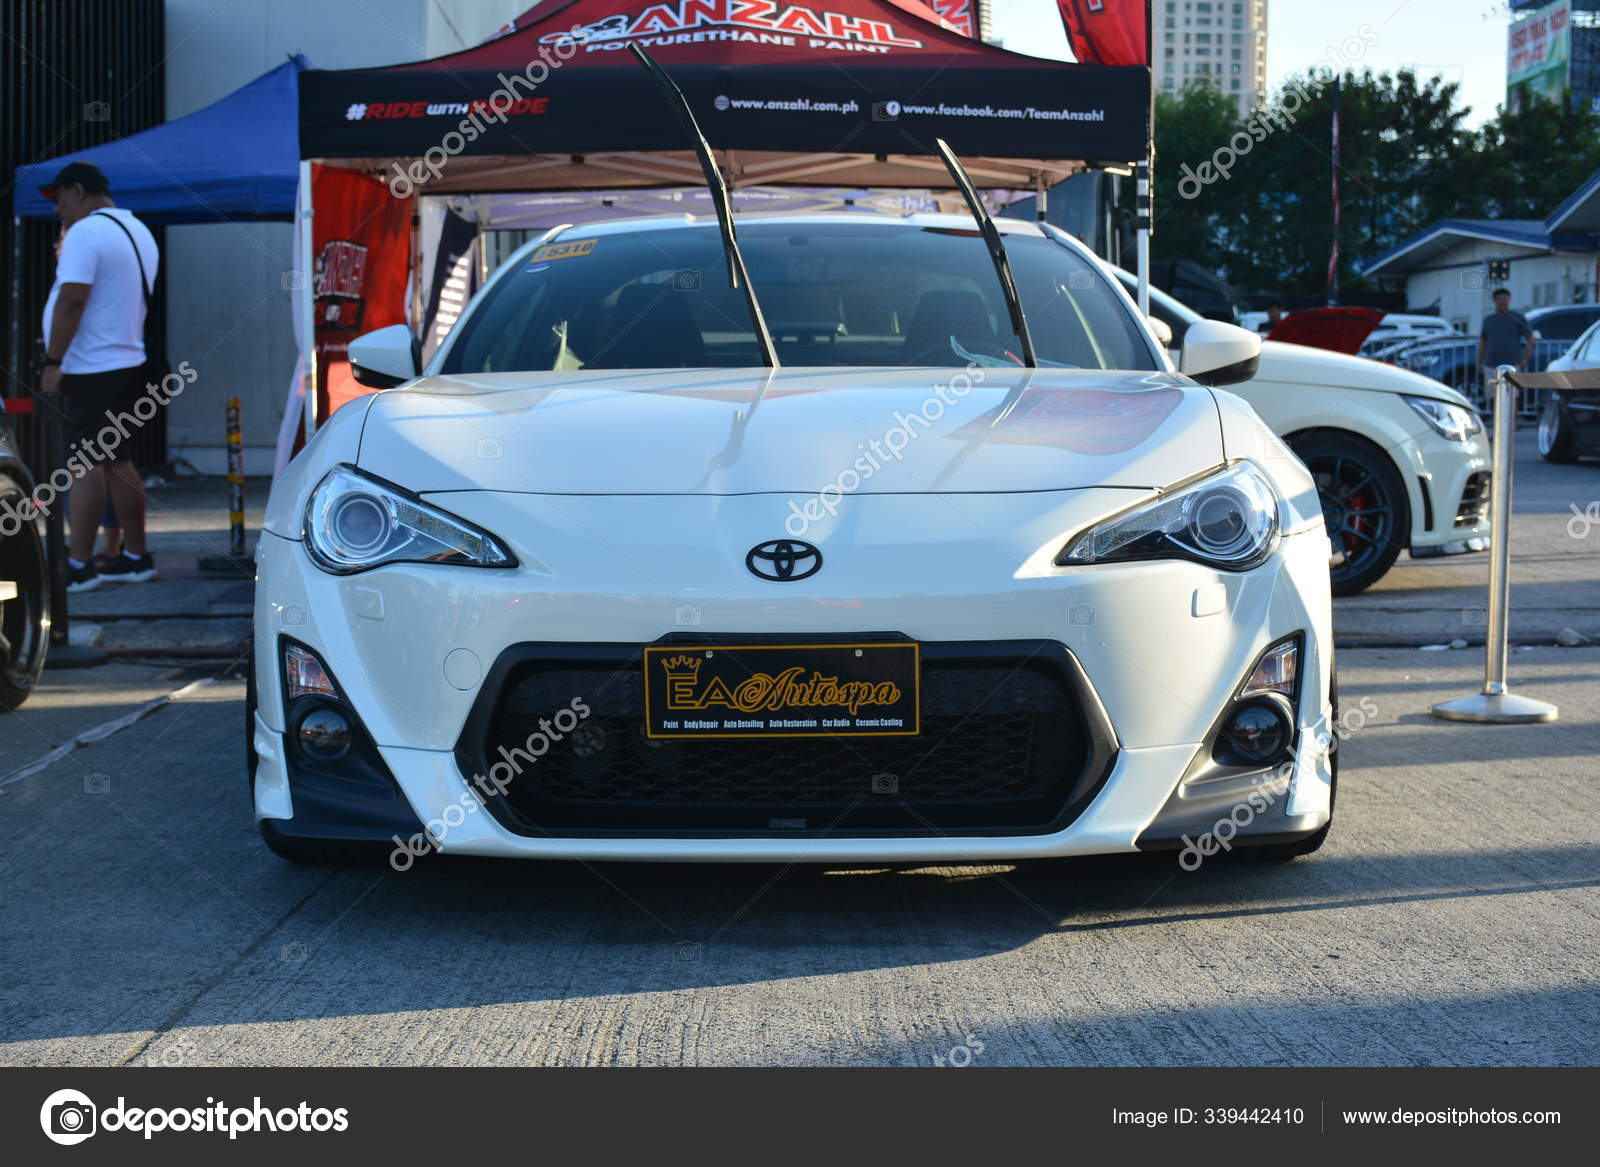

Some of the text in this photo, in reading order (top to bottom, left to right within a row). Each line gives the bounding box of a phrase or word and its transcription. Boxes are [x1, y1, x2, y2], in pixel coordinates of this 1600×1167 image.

[627, 0, 922, 48] ANZAHL
[809, 39, 891, 54] PAINT
[427, 103, 470, 116] WITH
[731, 99, 859, 115] www.anzahl.com.ph
[903, 104, 1105, 121] www.facebook.com/TeamAnzahl
[734, 666, 901, 716] Autospa
[663, 717, 903, 730] Paint Body Repair Auto Detailing Auto Restoration Car Audio Ceramic Coating
